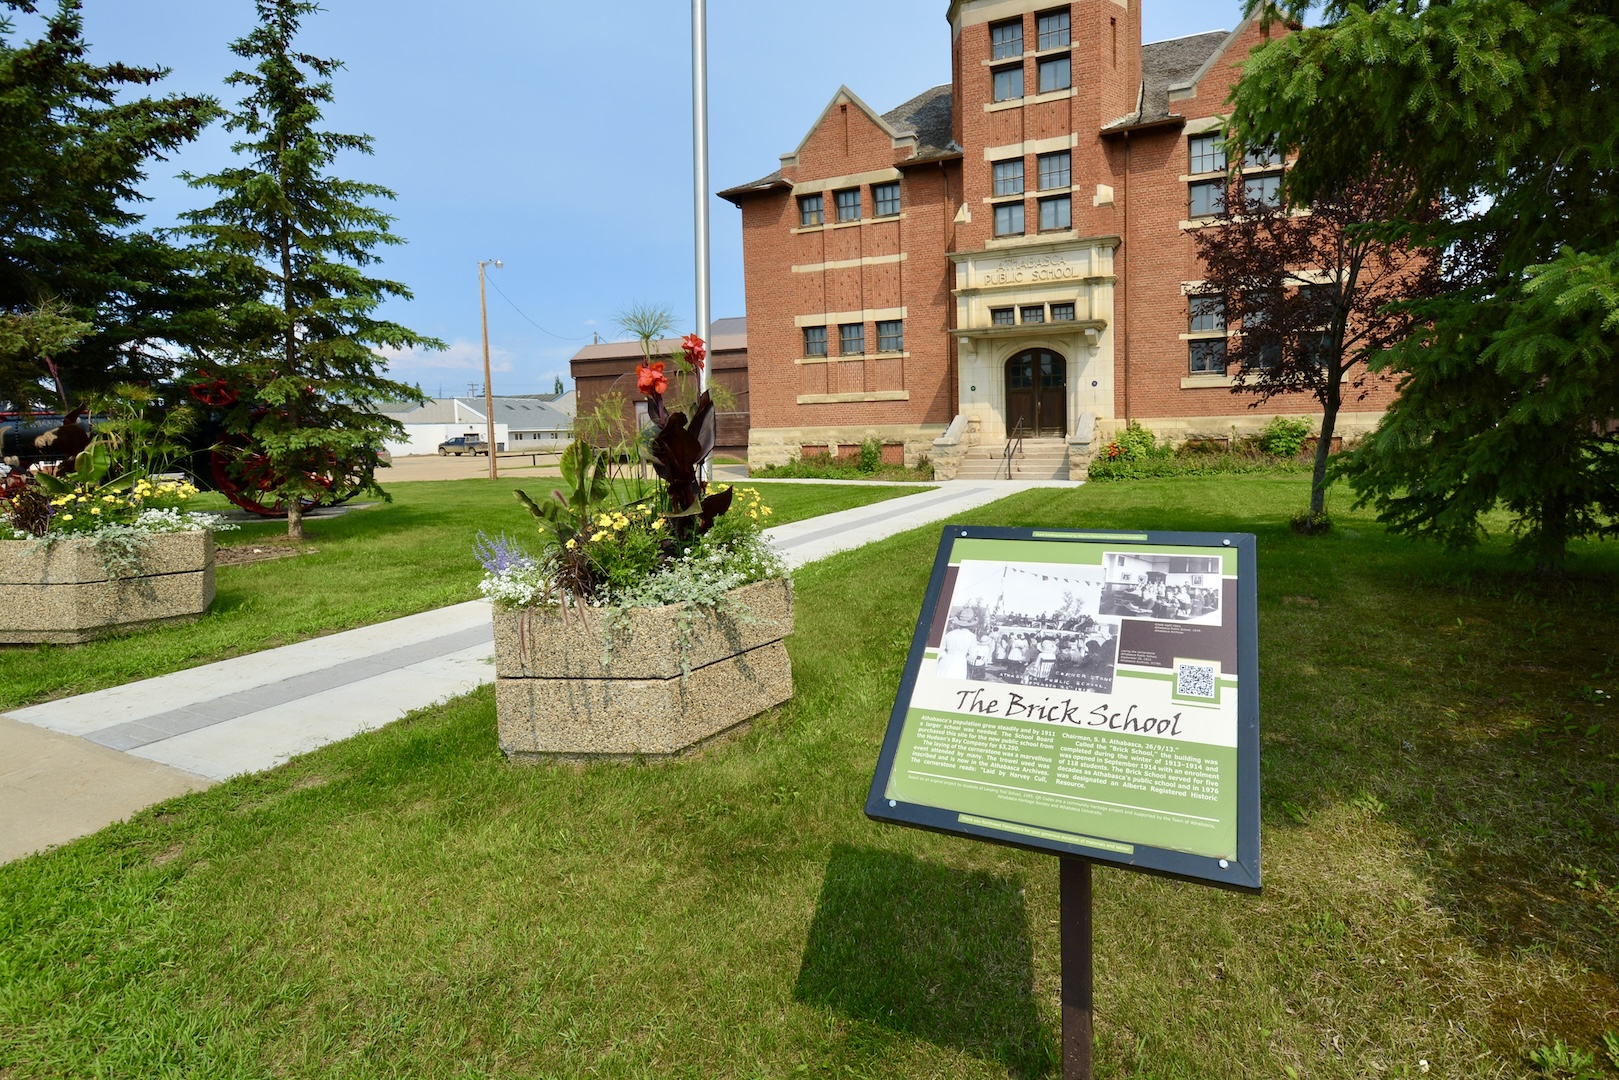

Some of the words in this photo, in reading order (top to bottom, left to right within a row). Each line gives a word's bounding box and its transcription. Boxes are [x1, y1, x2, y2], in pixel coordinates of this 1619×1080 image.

[996, 255, 1066, 272] ATHABASCA
[984, 272, 1024, 285] PUBLIC
[1032, 267, 1078, 282] SCHOOL
[921, 715, 952, 724] Athabasca's
[956, 688, 1000, 714] The
[1006, 692, 1082, 725] Brick
[1088, 705, 1182, 736] School
[963, 739, 988, 748] Company
[1062, 733, 1092, 742] Chairman,
[1109, 739, 1144, 749] Athabasca,
[933, 741, 950, 749] laying
[968, 747, 1001, 755] cornerstone
[1020, 754, 1052, 763] marvellous
[1060, 747, 1092, 755] completed
[1094, 750, 1115, 759] during
[1174, 754, 1202, 763] building
[912, 751, 937, 759] inscribed
[990, 762, 1020, 772] Athabasca
[1022, 767, 1049, 776] Archives.
[924, 760, 956, 769] cornerstone
[1010, 772, 1030, 781] Harvey
[1080, 762, 1109, 771] students.
[1144, 771, 1166, 779] School
[1104, 758, 1139, 768] September
[1184, 770, 1220, 780] enrolment
[1056, 779, 1086, 788] Resource.
[1058, 765, 1083, 774] decades
[1093, 771, 1131, 781] Athabasca's
[1202, 786, 1219, 794] 1976
[1072, 774, 1107, 785] designated
[1123, 782, 1146, 791] Alberta
[1150, 786, 1187, 797] Registered
[1191, 792, 1218, 802] Historic
